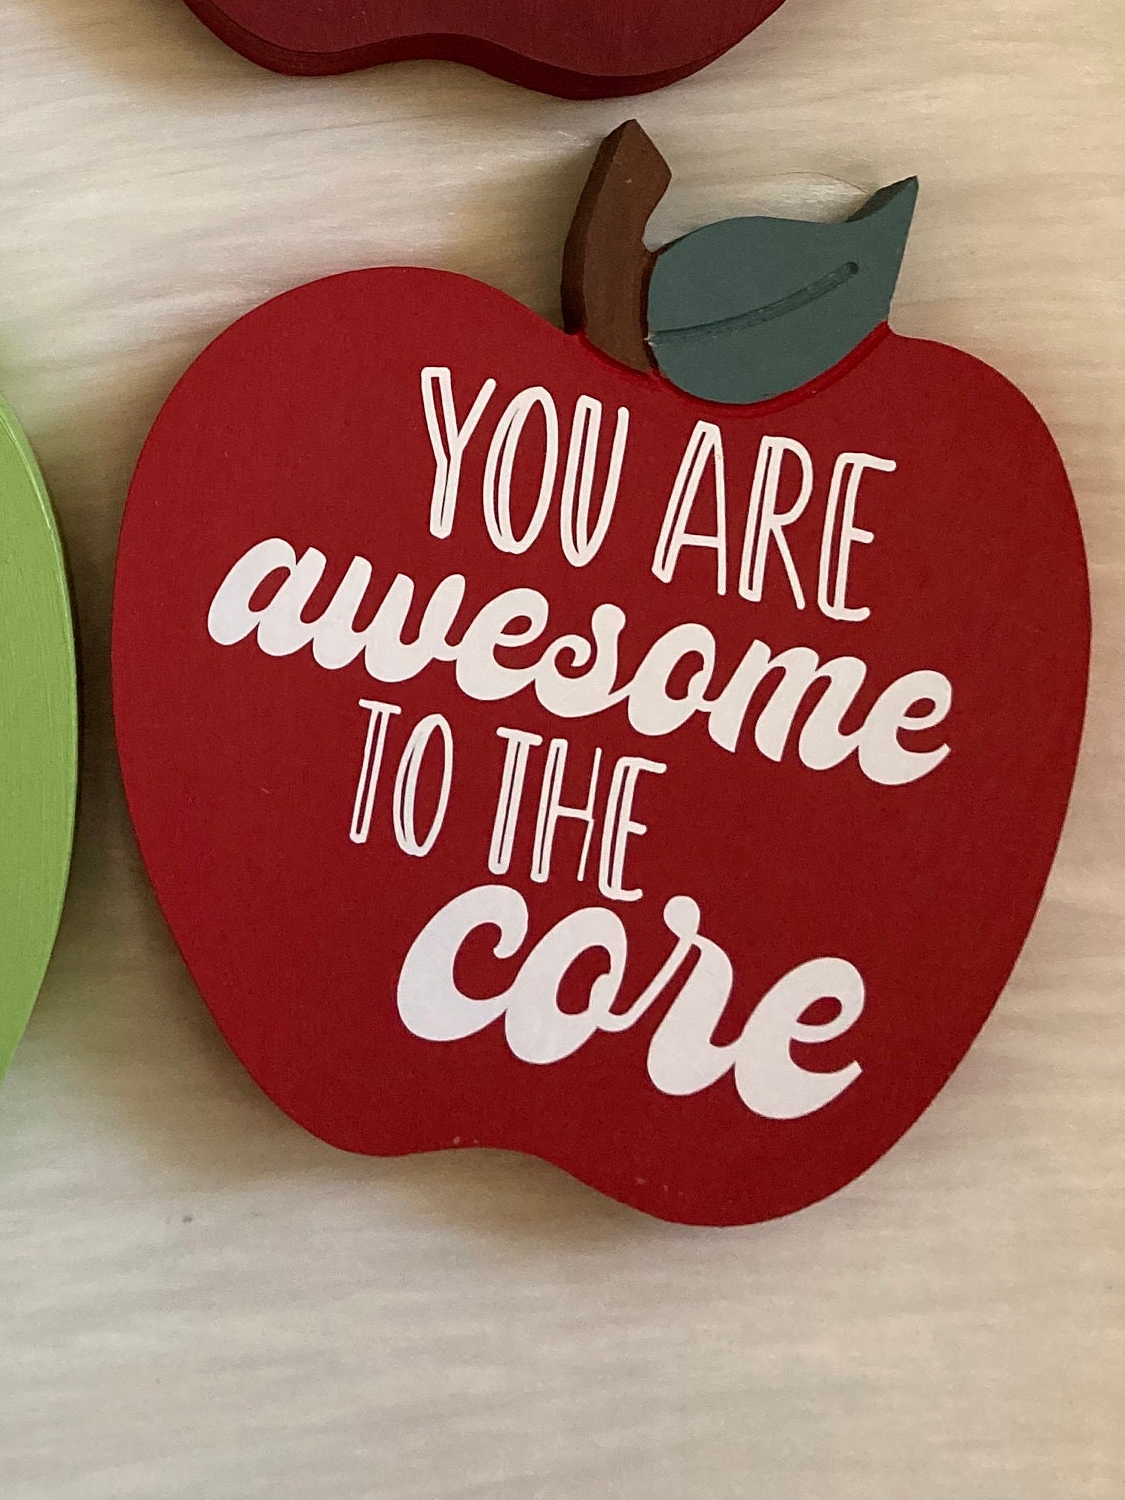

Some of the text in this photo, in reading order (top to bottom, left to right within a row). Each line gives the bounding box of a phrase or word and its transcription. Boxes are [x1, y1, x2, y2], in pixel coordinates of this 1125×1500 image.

[421, 367, 896, 621] YOU ARE
[208, 538, 952, 785] awesome
[350, 699, 667, 901] TO THE
[397, 885, 865, 1119] core
